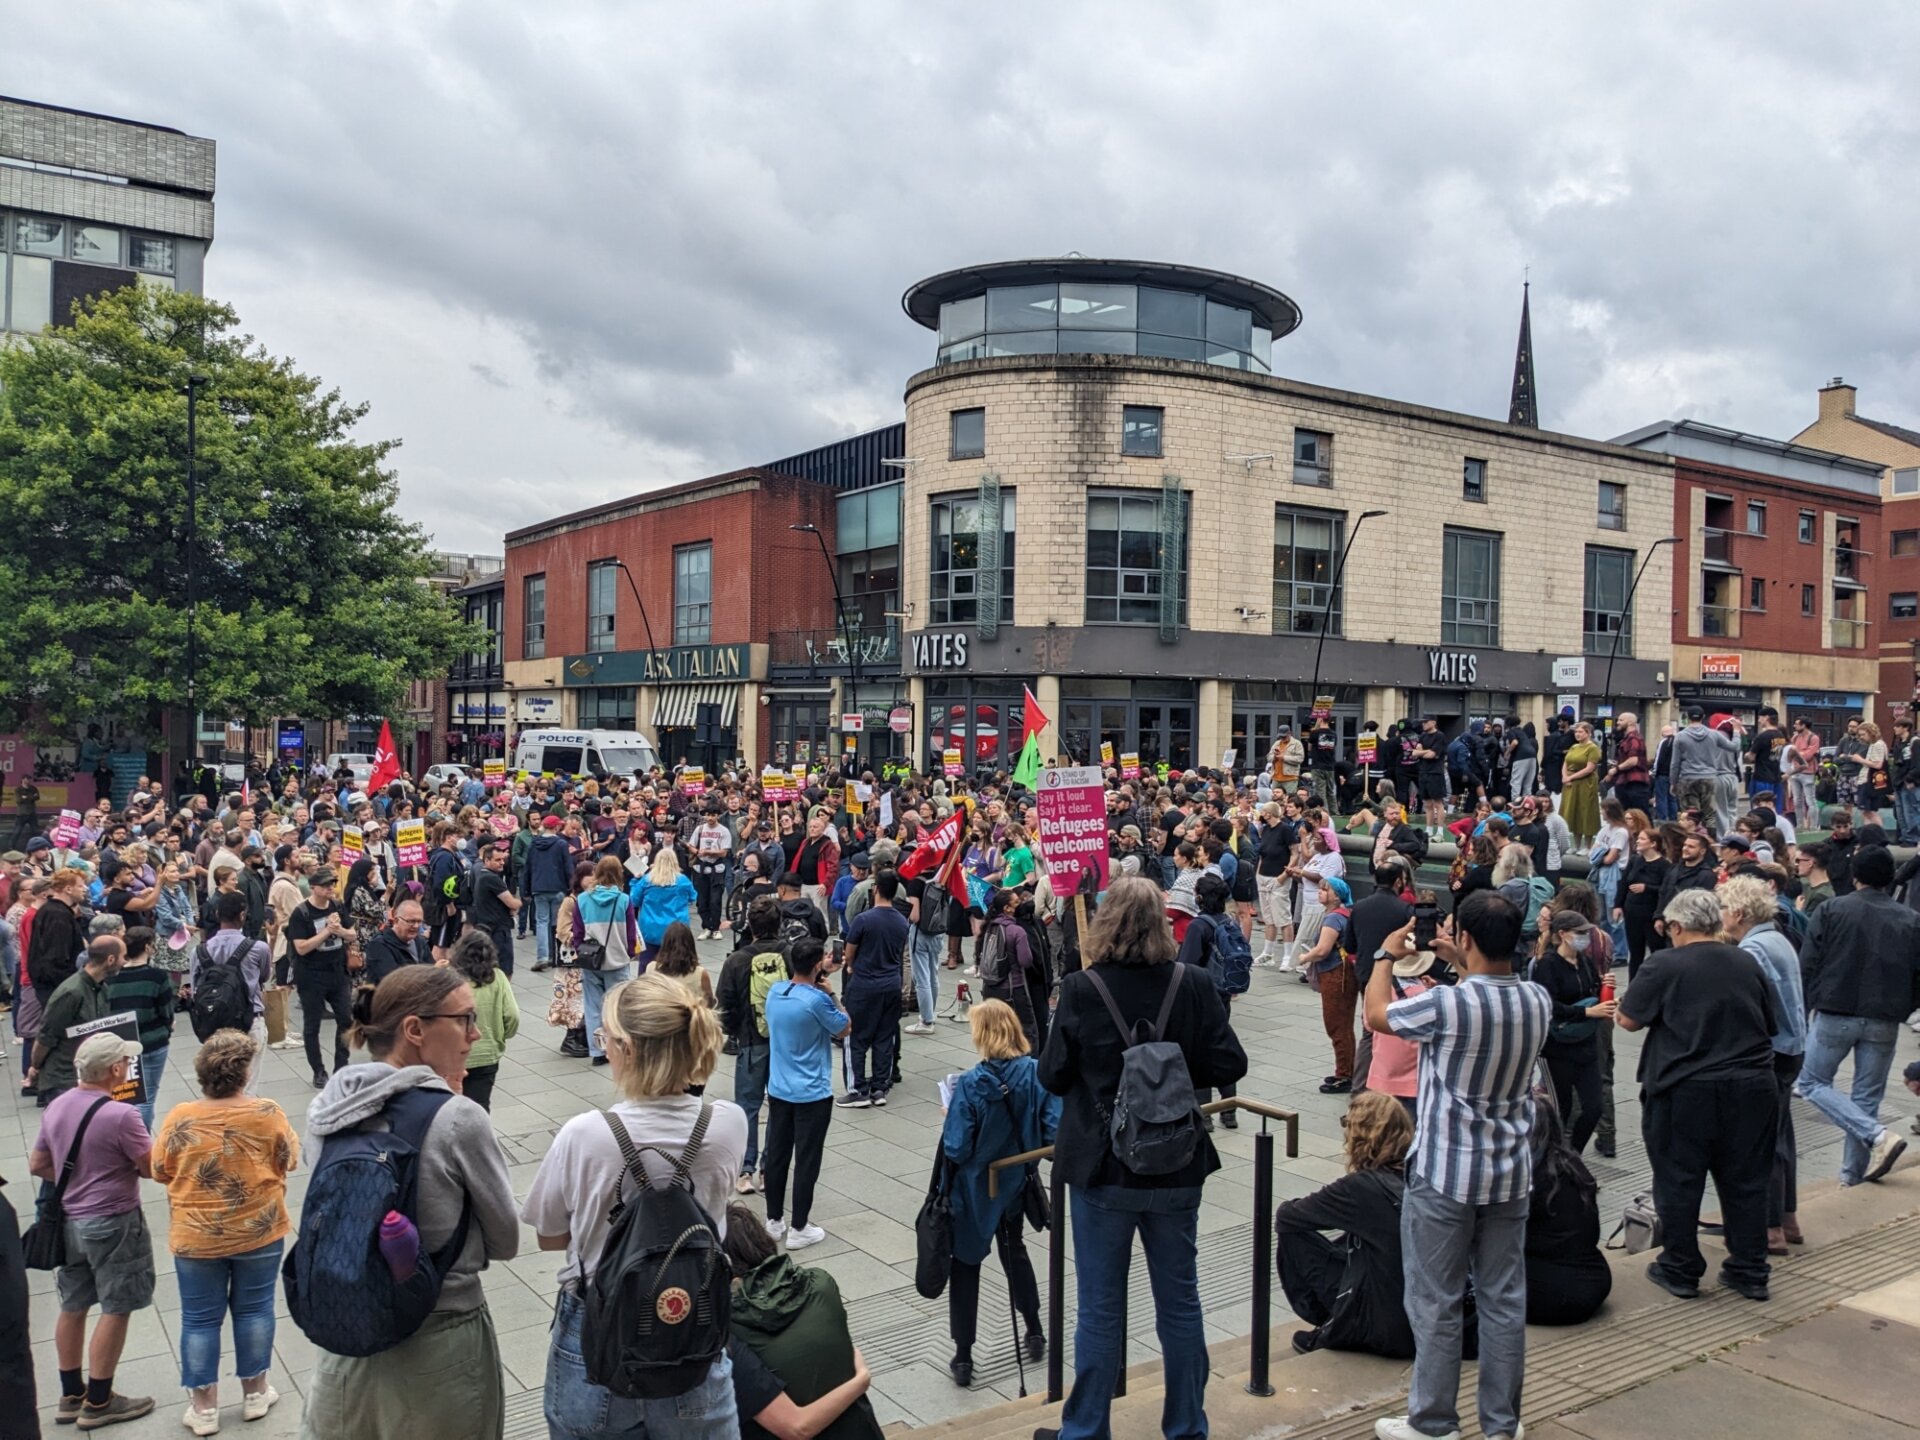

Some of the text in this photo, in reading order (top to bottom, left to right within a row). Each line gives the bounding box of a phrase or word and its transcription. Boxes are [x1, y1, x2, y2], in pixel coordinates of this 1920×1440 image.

[912, 633, 966, 666] YATES
[644, 648, 740, 679] ASK ITALIAN
[1430, 652, 1476, 682] YATES
[1704, 664, 1738, 672] TO LET
[1562, 668, 1578, 676] YATES
[538, 735, 584, 743] POLICE
[1039, 790, 1084, 805] Say it loud
[1040, 802, 1092, 817] Say it clear:
[398, 829, 422, 837] Refugees
[1040, 816, 1104, 836] Refugees
[400, 846, 411, 854] Stop
[1043, 836, 1104, 855] welcome
[408, 853, 422, 862] right
[1046, 857, 1079, 874] here
[75, 1016, 128, 1034] Socialist Worker
